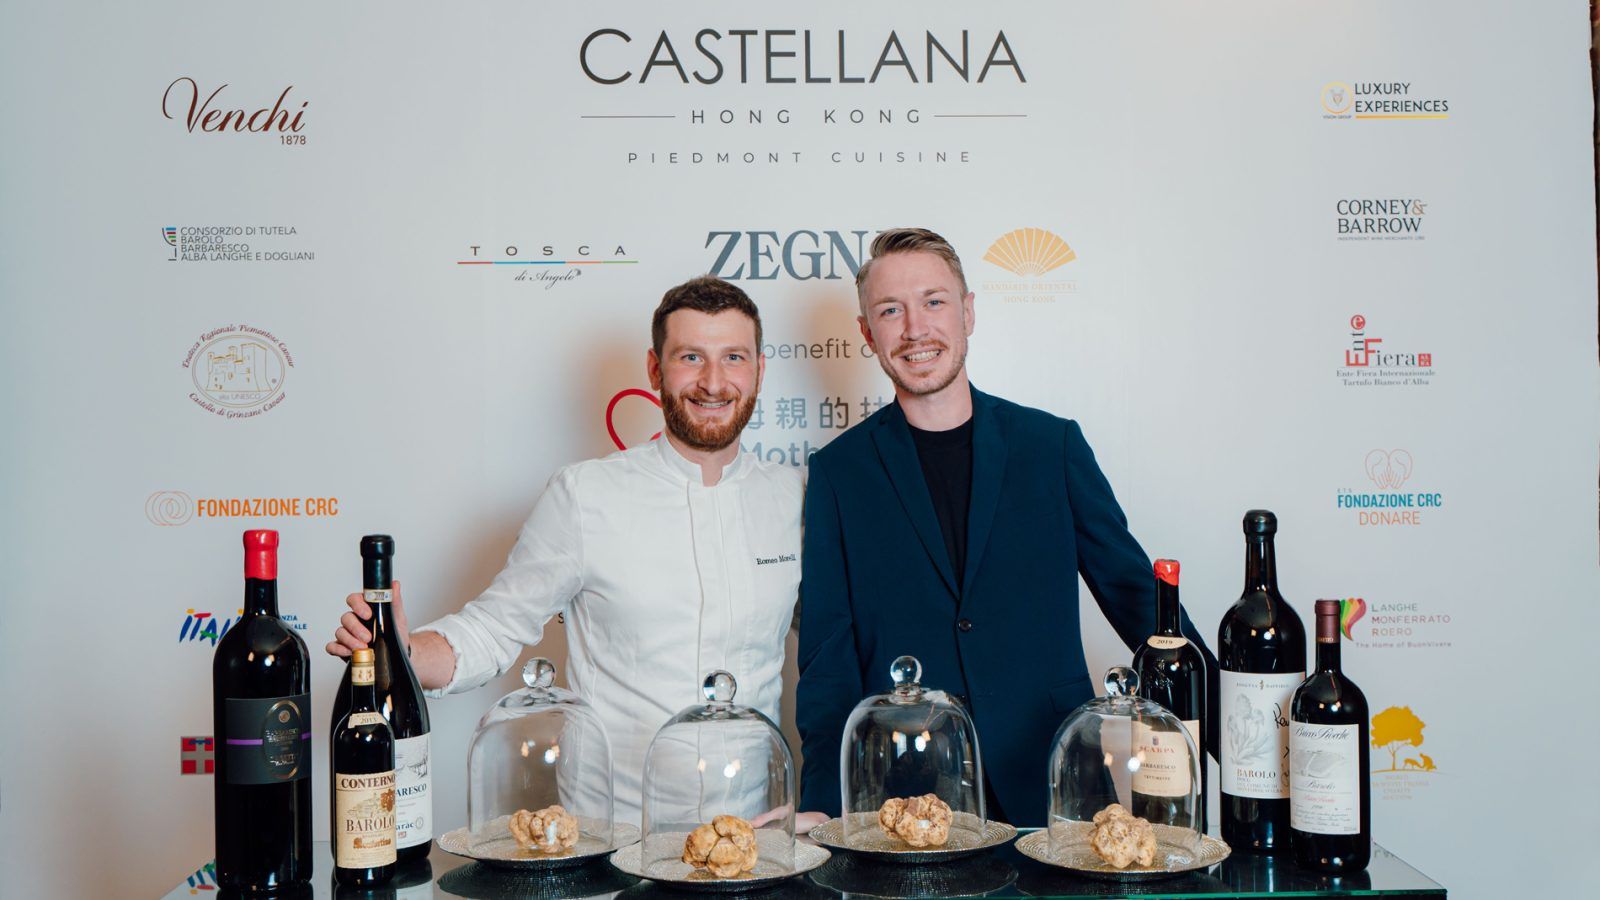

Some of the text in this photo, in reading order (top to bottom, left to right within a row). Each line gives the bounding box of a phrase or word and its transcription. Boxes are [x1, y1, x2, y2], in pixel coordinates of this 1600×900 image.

[579, 28, 1027, 85] CASTELLANA
[1355, 83, 1411, 95] LUXURY
[162, 77, 309, 134] Venchi
[1355, 100, 1449, 112] EXPERIENCES
[691, 109, 920, 124] HONG KONG
[280, 135, 307, 146] 1878
[628, 150, 970, 164] PIEDMONT CUISINE
[180, 226, 297, 236] CONSORZIO DI TUTELA
[1338, 217, 1422, 234] BARROW
[180, 235, 224, 244] BAROLO
[180, 243, 250, 252] BARBARESCO
[470, 246, 626, 256] TOSCA
[180, 252, 315, 261] ALBA LANGHE E DOGLIANI
[704, 230, 874, 280] ZEGN
[514, 270, 575, 290] di Angelo
[762, 338, 851, 359] benefit
[197, 497, 339, 517] FONDAZIONE CRC
[1337, 493, 1442, 508] FONDAZIONE CRC
[1359, 511, 1421, 525] DONARE
[1371, 603, 1418, 613] LANGHE
[1371, 614, 1451, 625] MONFERRATO
[1371, 627, 1413, 637] ROERO
[1236, 768, 1276, 779] BAROLO
[341, 774, 396, 789] CONTERNO
[345, 814, 395, 832] BAROLO
